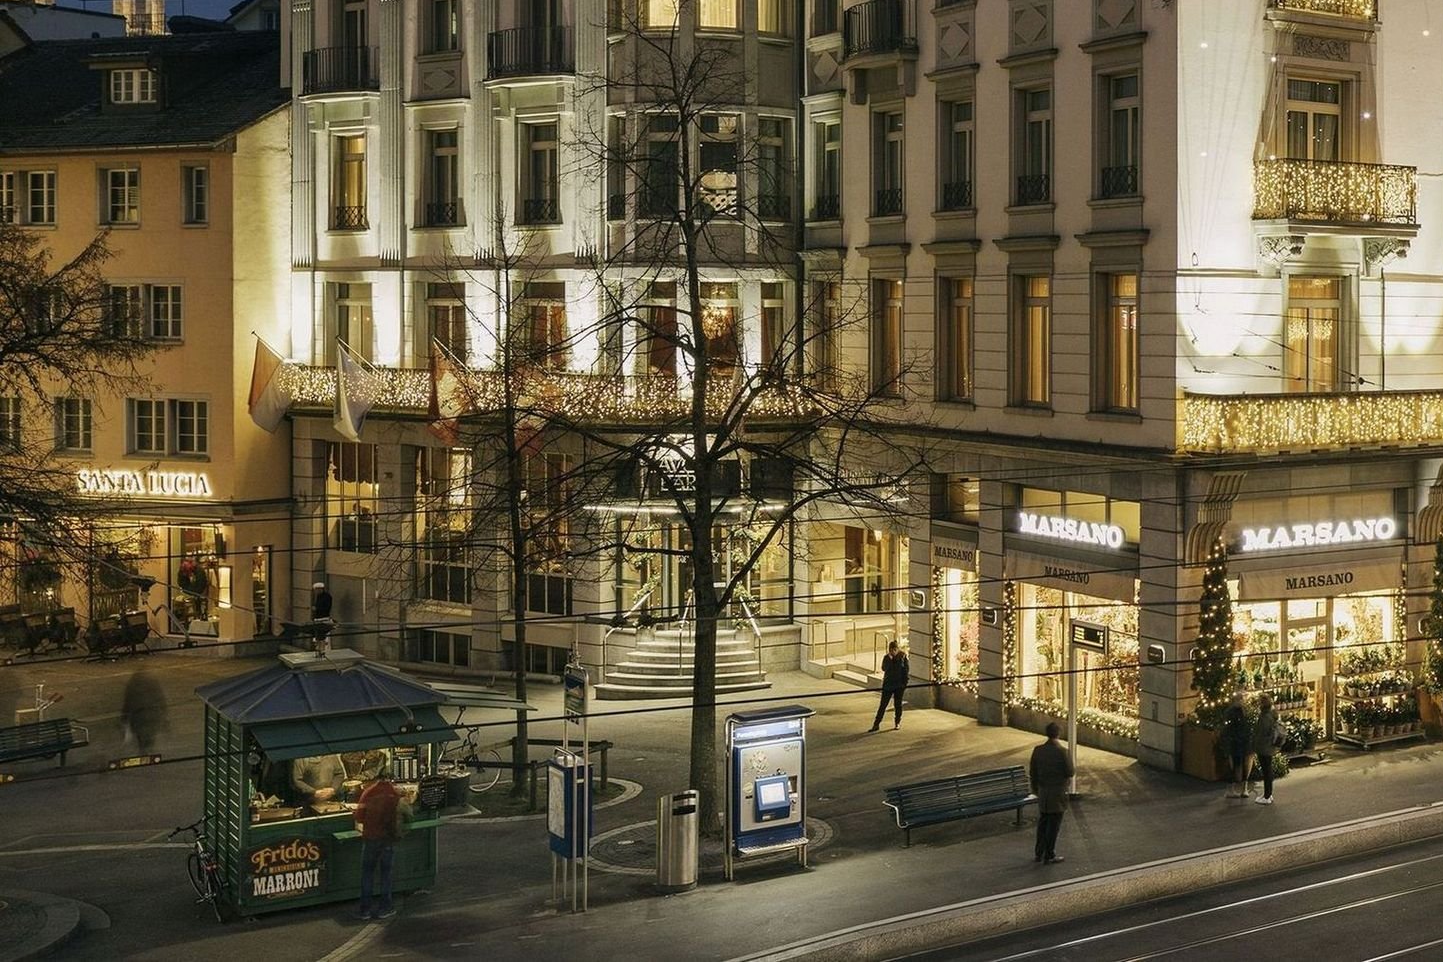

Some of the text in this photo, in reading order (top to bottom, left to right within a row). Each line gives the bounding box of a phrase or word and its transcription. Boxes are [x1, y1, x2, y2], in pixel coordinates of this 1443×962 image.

[77, 469, 212, 496] SANTA LUCIA
[1019, 512, 1124, 549] MARSANO
[1242, 517, 1396, 551] MARSANO
[934, 545, 974, 563] MARSANO
[1045, 566, 1090, 585] MARSANO
[1285, 572, 1354, 590] MARSANO
[251, 839, 320, 873] Frido's
[253, 868, 319, 896] MARRONI
